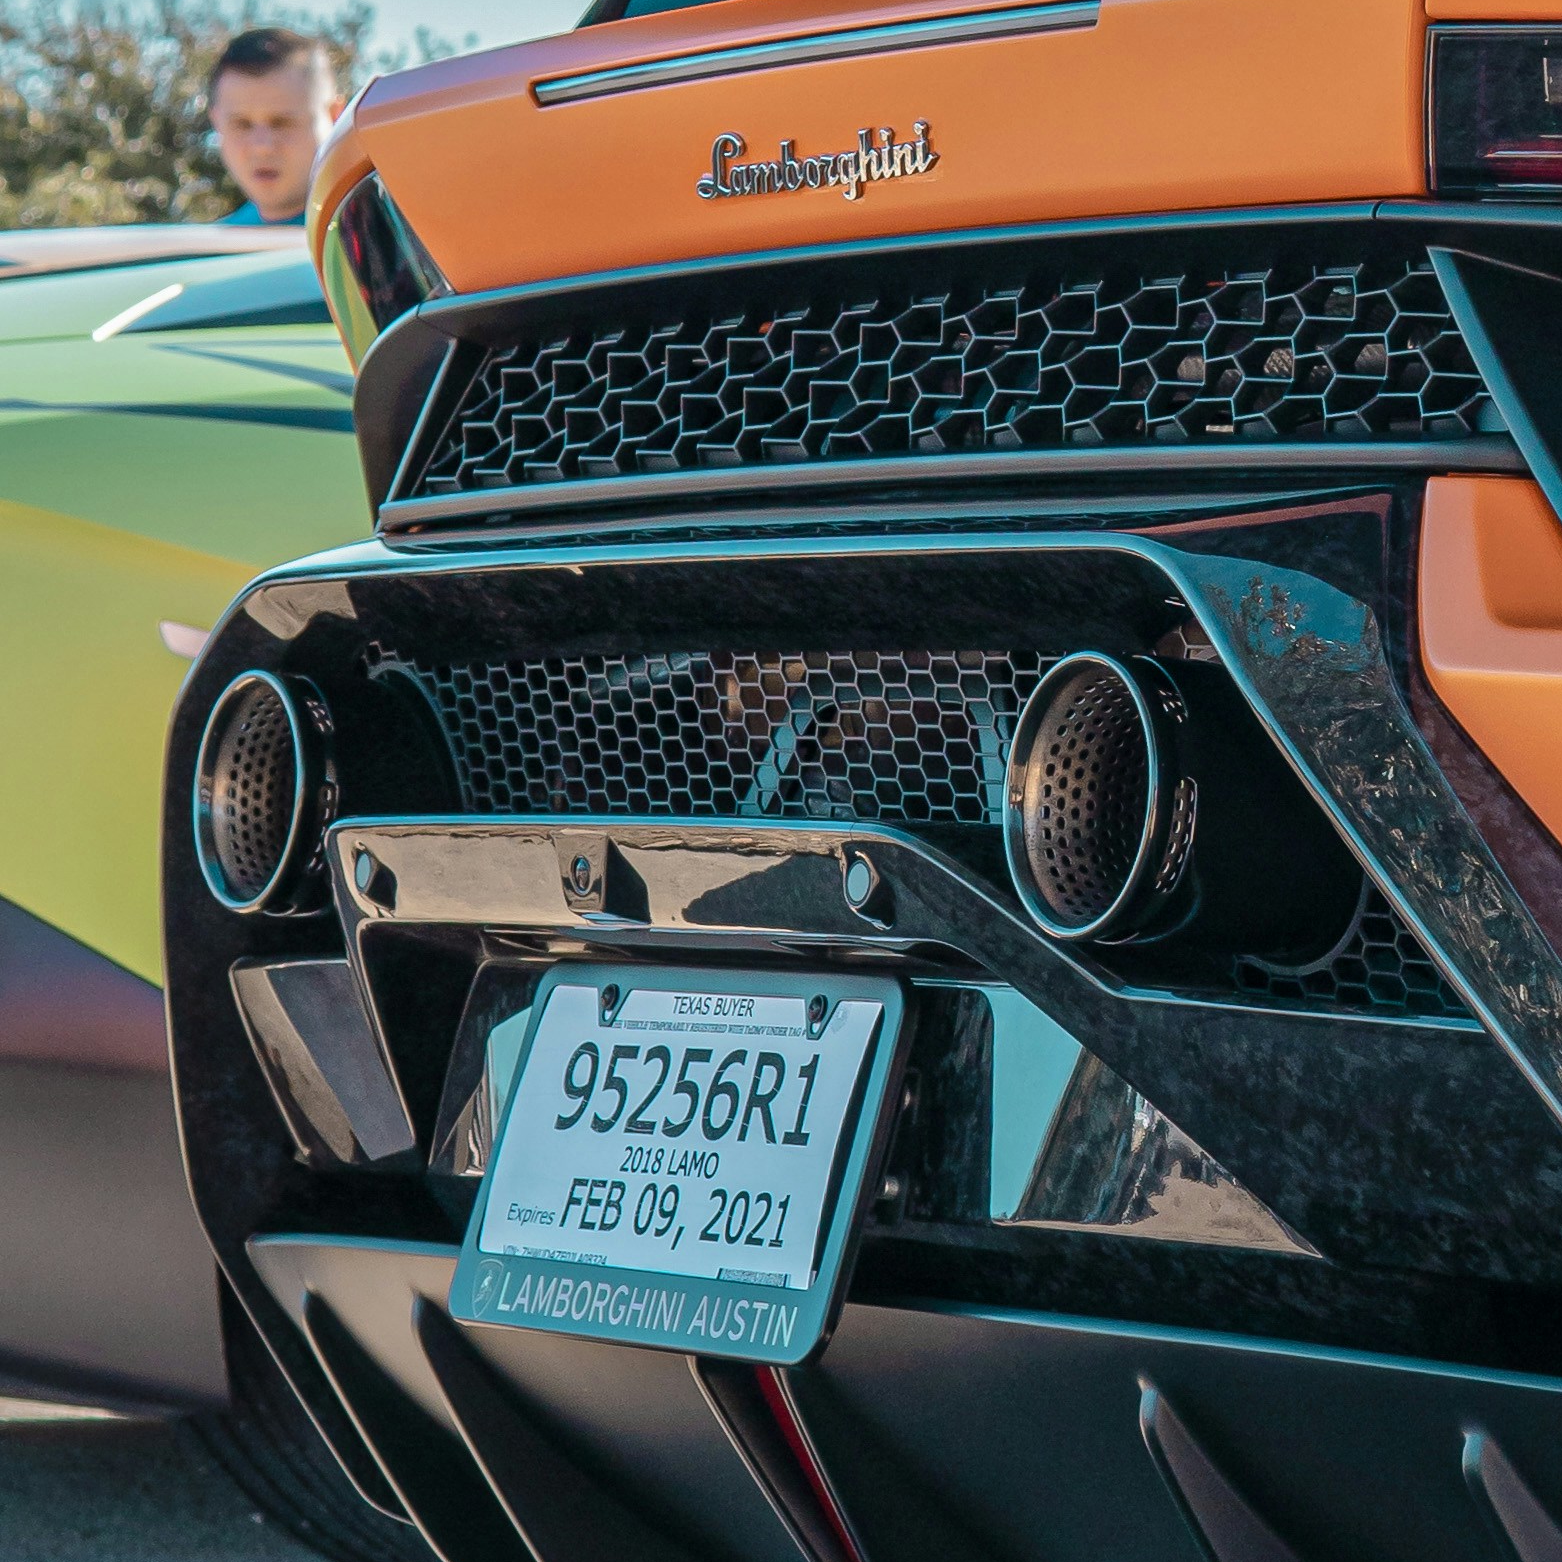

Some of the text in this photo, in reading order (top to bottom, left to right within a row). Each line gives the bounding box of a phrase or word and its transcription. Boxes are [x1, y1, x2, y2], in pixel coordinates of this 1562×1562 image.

[696, 118, 940, 200] Lamborghini
[672, 995, 756, 1018] TEXAS BUYER
[554, 1041, 821, 1146] 95256R1
[619, 1145, 720, 1179] 2018 LAMO
[506, 1177, 791, 1251] Expires FEB 09, 2021
[497, 1271, 798, 1348] LAMBORGHINI AUSTIN
